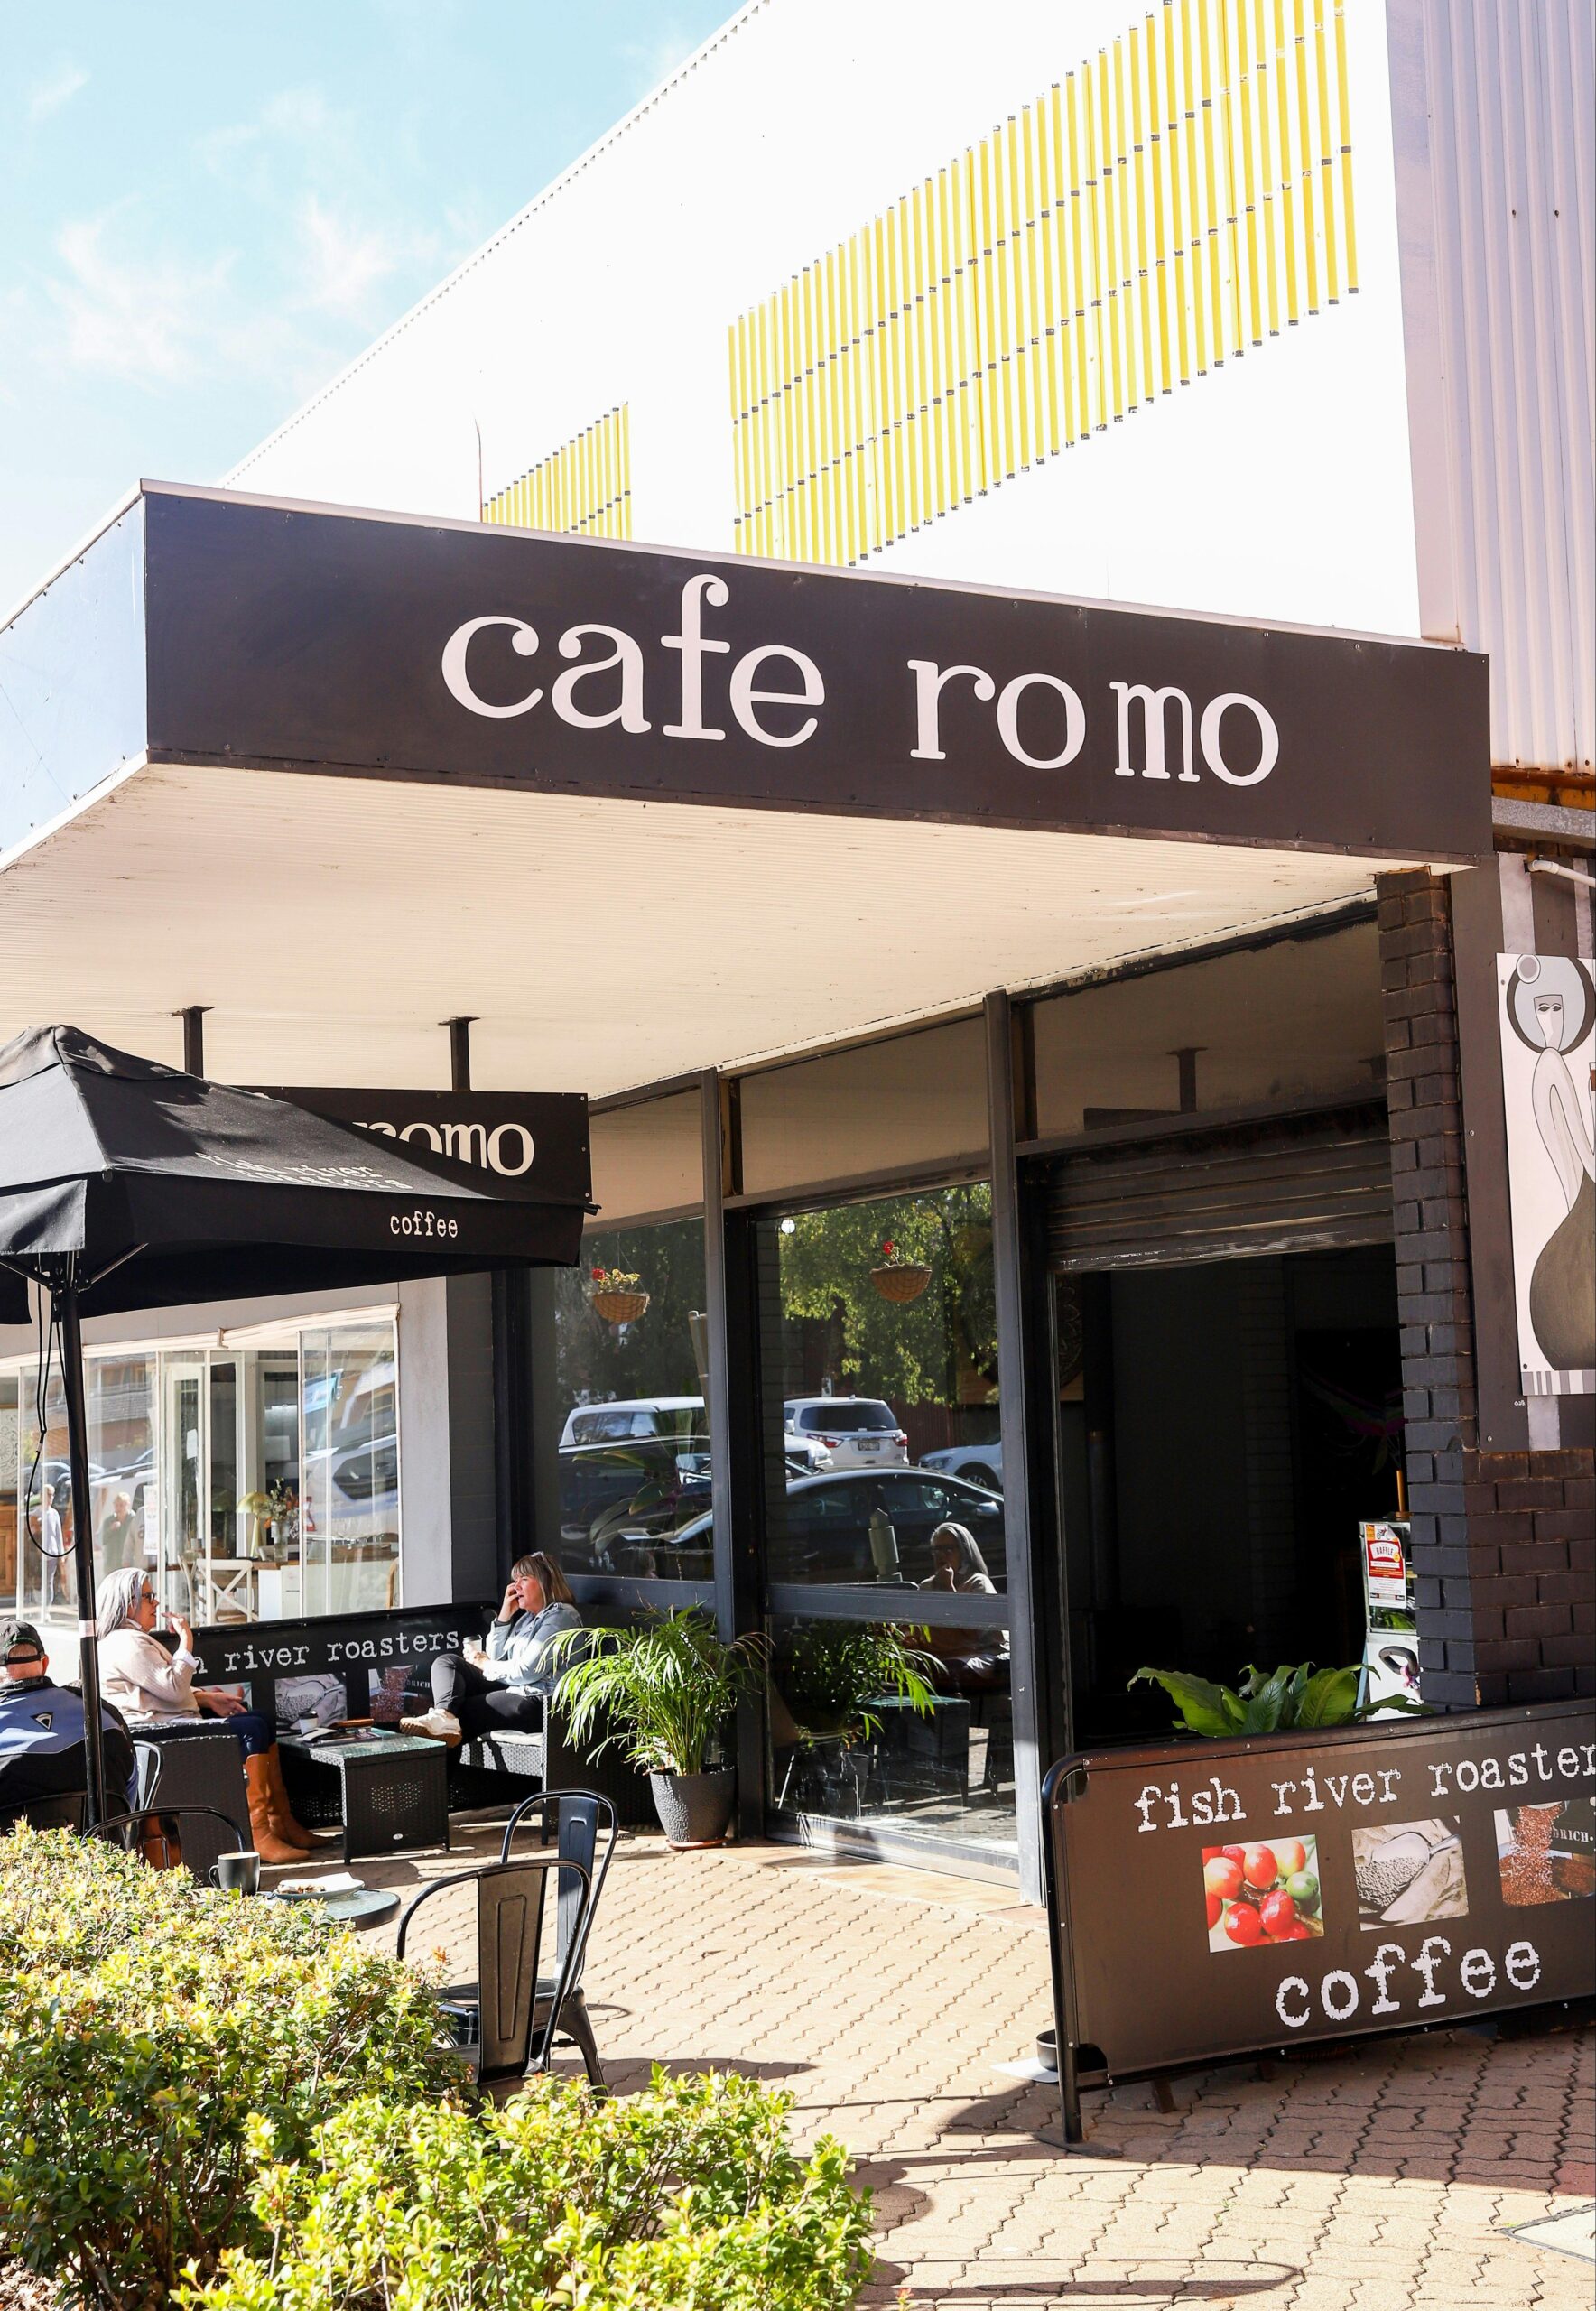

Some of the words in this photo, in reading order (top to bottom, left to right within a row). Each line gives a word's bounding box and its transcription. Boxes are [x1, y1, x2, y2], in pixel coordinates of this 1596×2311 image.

[441, 574, 825, 747] cafe
[906, 659, 1279, 787] romo
[390, 1211, 459, 1239] coffee
[1376, 1545, 1395, 1556] RAFFLE
[224, 1644, 310, 1672] river
[327, 1630, 459, 1662] roasters
[1133, 1777, 1248, 1833] fish
[1270, 1766, 1402, 1816] river
[1275, 1935, 1542, 2028] coffee
